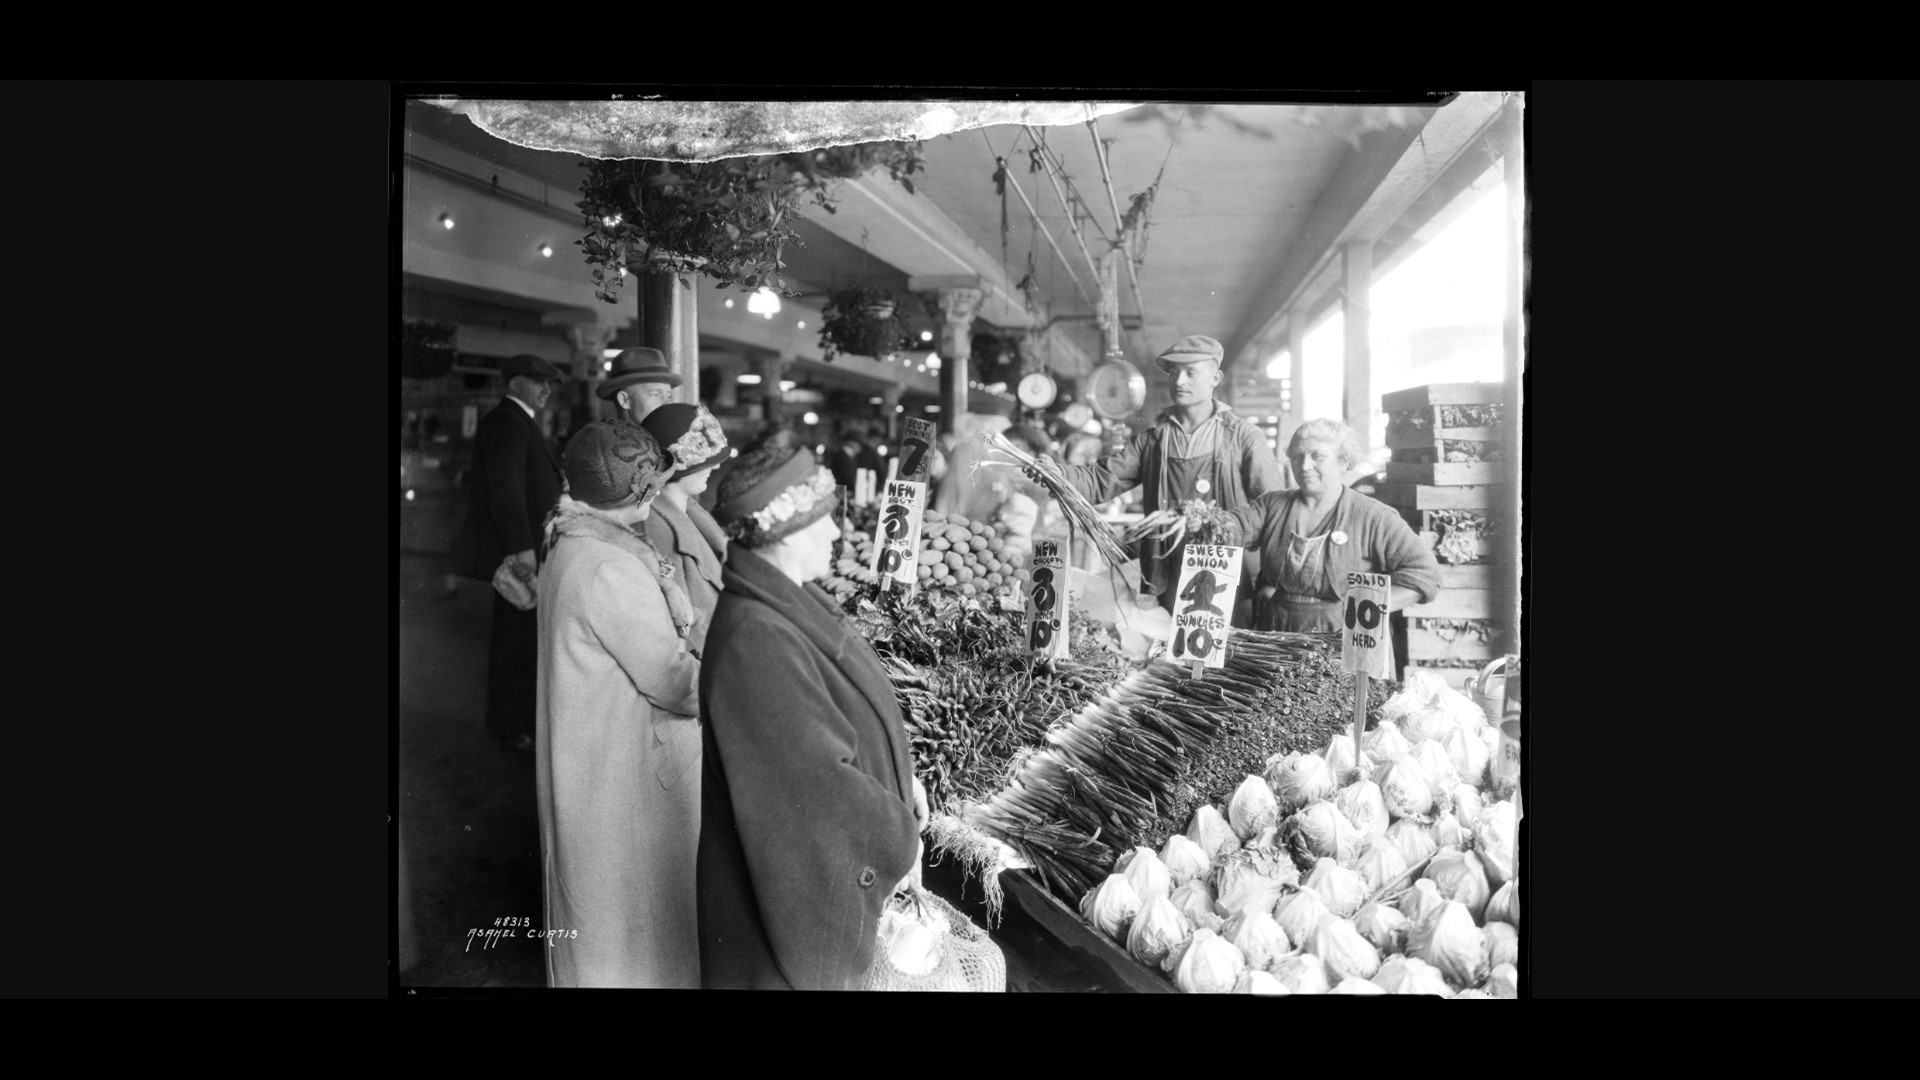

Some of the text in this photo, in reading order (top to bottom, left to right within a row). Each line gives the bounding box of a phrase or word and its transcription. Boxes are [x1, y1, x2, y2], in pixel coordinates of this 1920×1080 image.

[902, 437, 930, 476] 7
[888, 482, 915, 498] NEW
[882, 504, 910, 540] 3
[1035, 541, 1058, 558] NEW
[1186, 545, 1237, 558] SWEET
[1187, 557, 1228, 570] ONION
[1347, 573, 1386, 587] SOLID
[1179, 570, 1228, 617] 4
[1176, 614, 1225, 632] BUNCHES
[1352, 632, 1376, 649] HEAD
